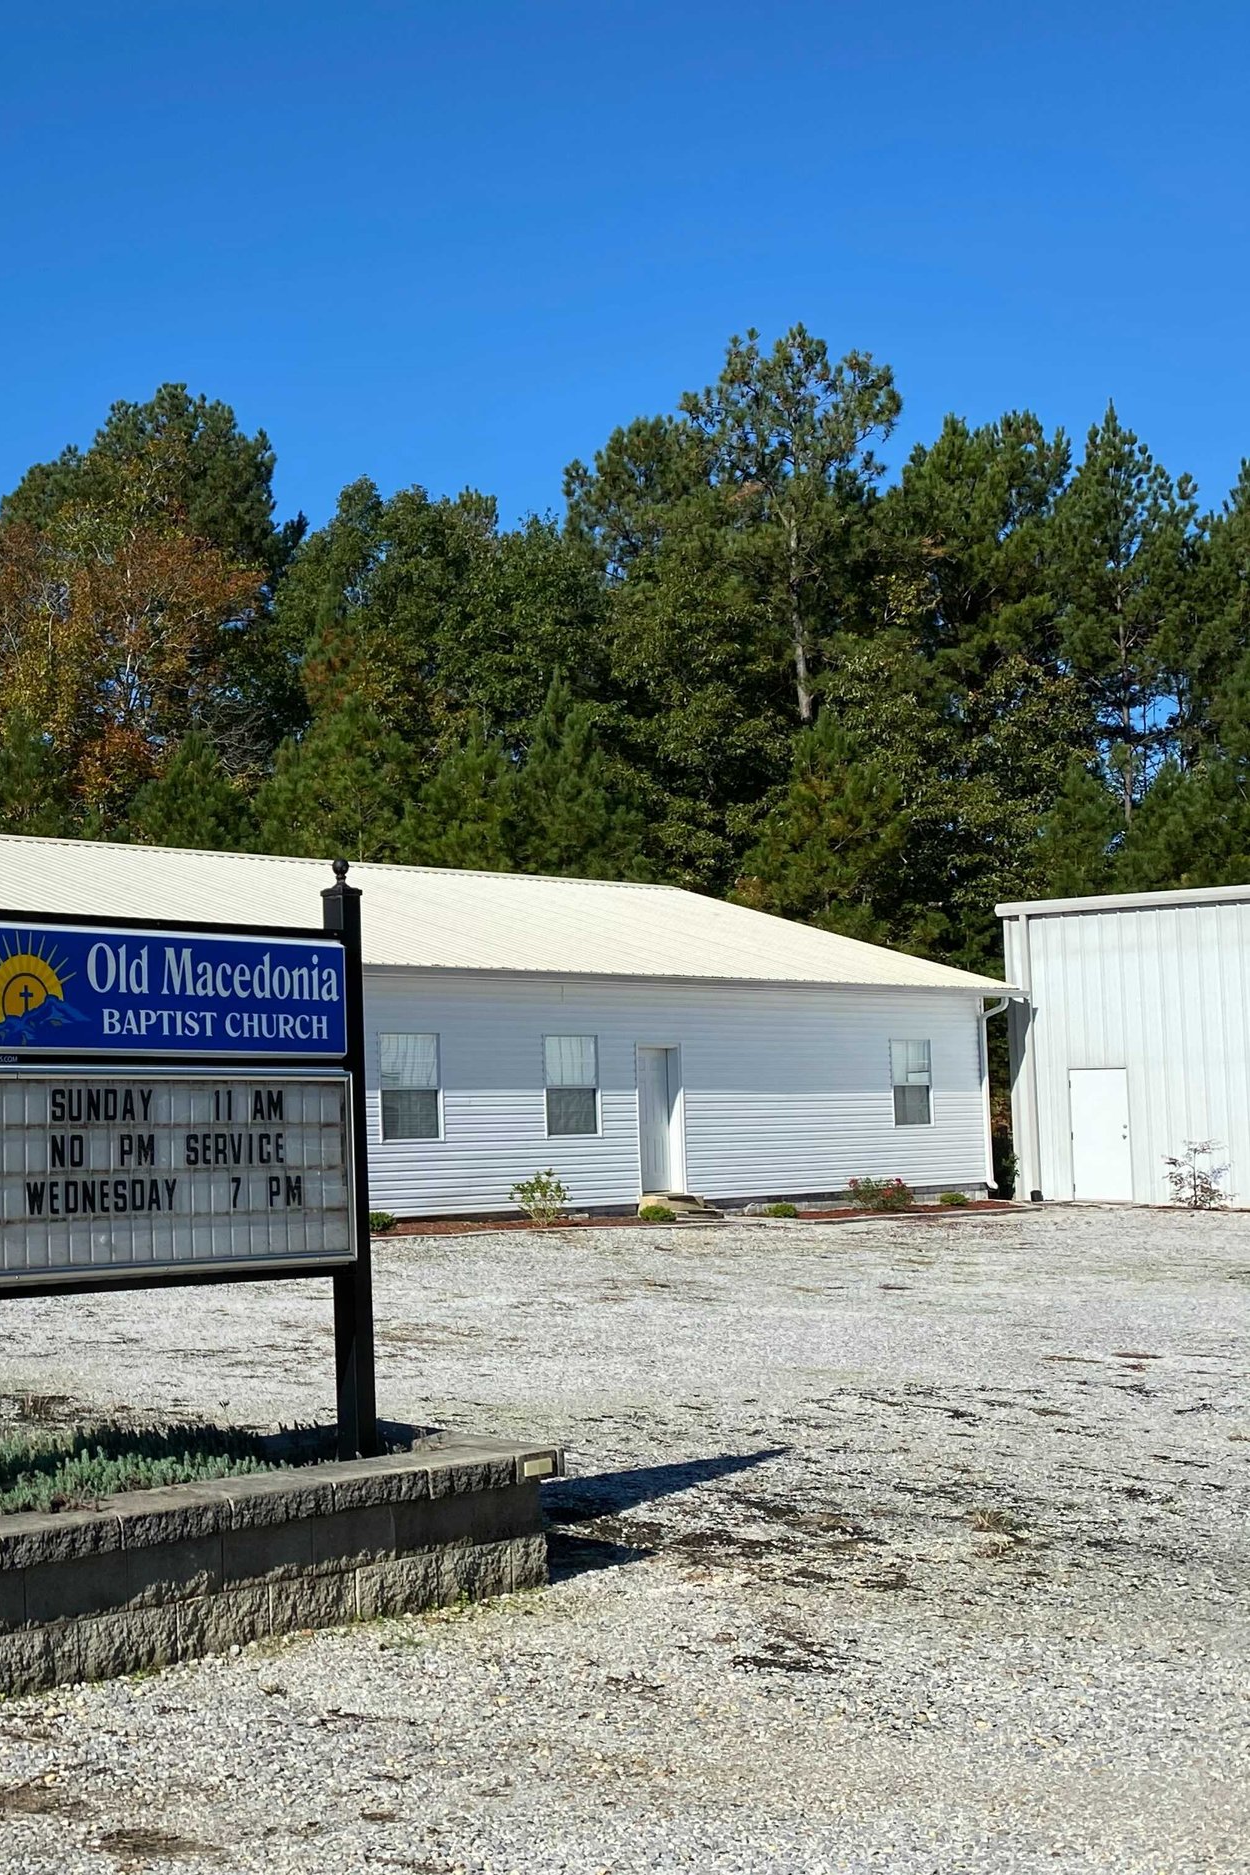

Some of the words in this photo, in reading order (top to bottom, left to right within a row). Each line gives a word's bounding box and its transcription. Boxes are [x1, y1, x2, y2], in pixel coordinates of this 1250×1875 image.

[87, 942, 149, 994] Old
[160, 946, 340, 1002] Macedonia
[102, 1008, 218, 1037] BAPTIST
[224, 1012, 329, 1040] CHURCH
[51, 1088, 152, 1122] SUNDAY
[214, 1090, 233, 1121] 11
[253, 1090, 284, 1121] AM
[51, 1134, 84, 1168] NO
[120, 1133, 155, 1166] PM
[185, 1133, 285, 1166] SERVICE
[26, 1178, 177, 1216] WEDNESDAY
[231, 1176, 241, 1209] 7
[269, 1175, 302, 1207] PM
